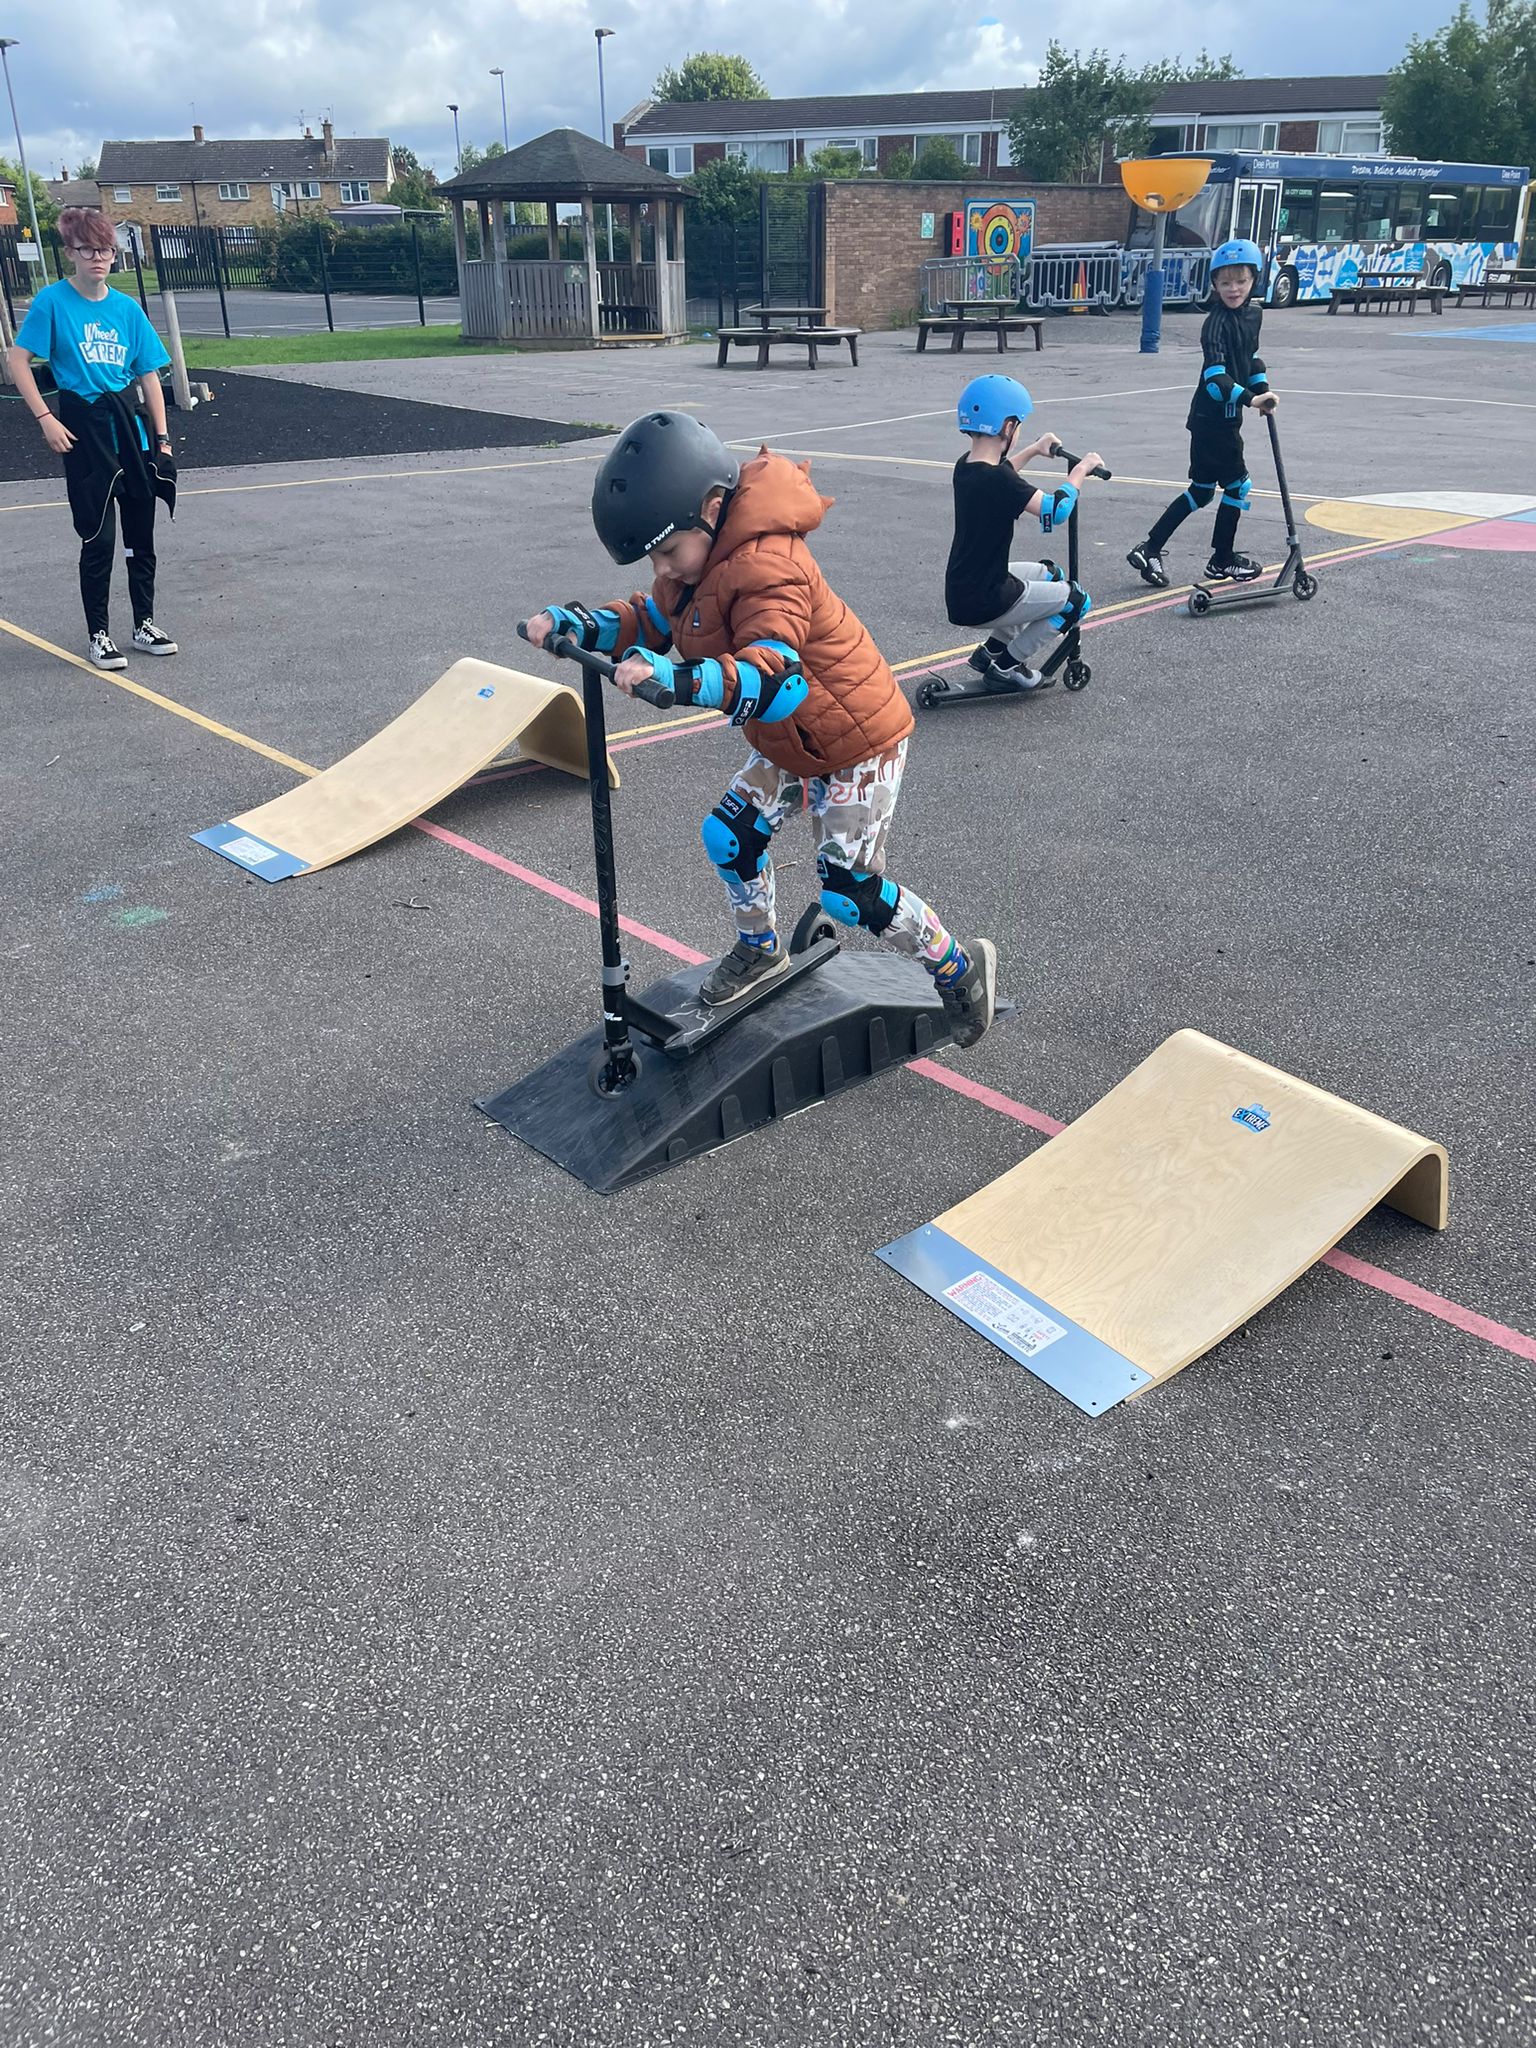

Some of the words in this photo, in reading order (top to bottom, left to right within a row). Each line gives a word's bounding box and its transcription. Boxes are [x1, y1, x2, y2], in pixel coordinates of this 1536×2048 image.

[1253, 158, 1265, 169] Dee
[1265, 159, 1279, 169] Point
[84, 321, 118, 343] Wheels
[80, 342, 127, 366] ETREM
[740, 700, 754, 718] SFR
[724, 798, 740, 813] SFR
[1233, 1108, 1269, 1131] EXTREME
[947, 1273, 982, 1298] WARNING
